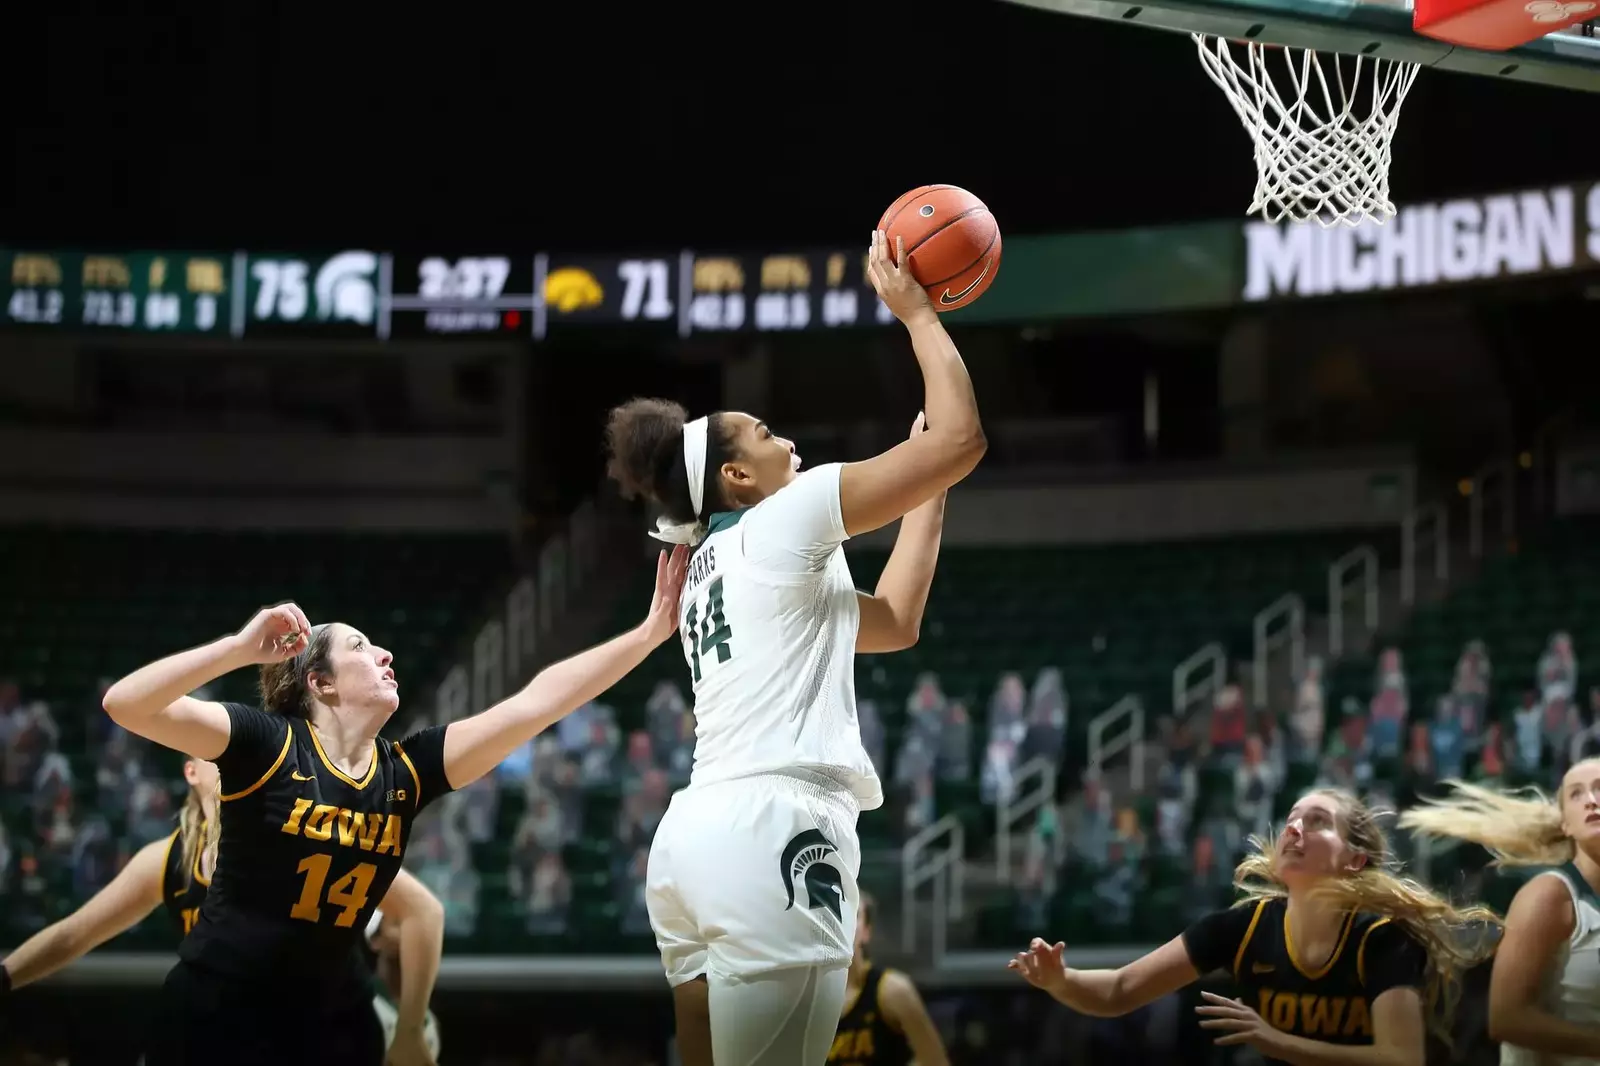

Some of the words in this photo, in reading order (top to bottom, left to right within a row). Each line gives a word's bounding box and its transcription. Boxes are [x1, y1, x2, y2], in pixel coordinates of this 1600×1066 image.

[1244, 186, 1575, 301] MICHIGAN
[252, 259, 309, 320] 75
[617, 260, 674, 319] 71
[687, 545, 715, 590] PARKS
[686, 575, 732, 683] 14
[281, 797, 402, 856] IOWA
[290, 853, 377, 928] 14
[1258, 987, 1372, 1037] IOWA
